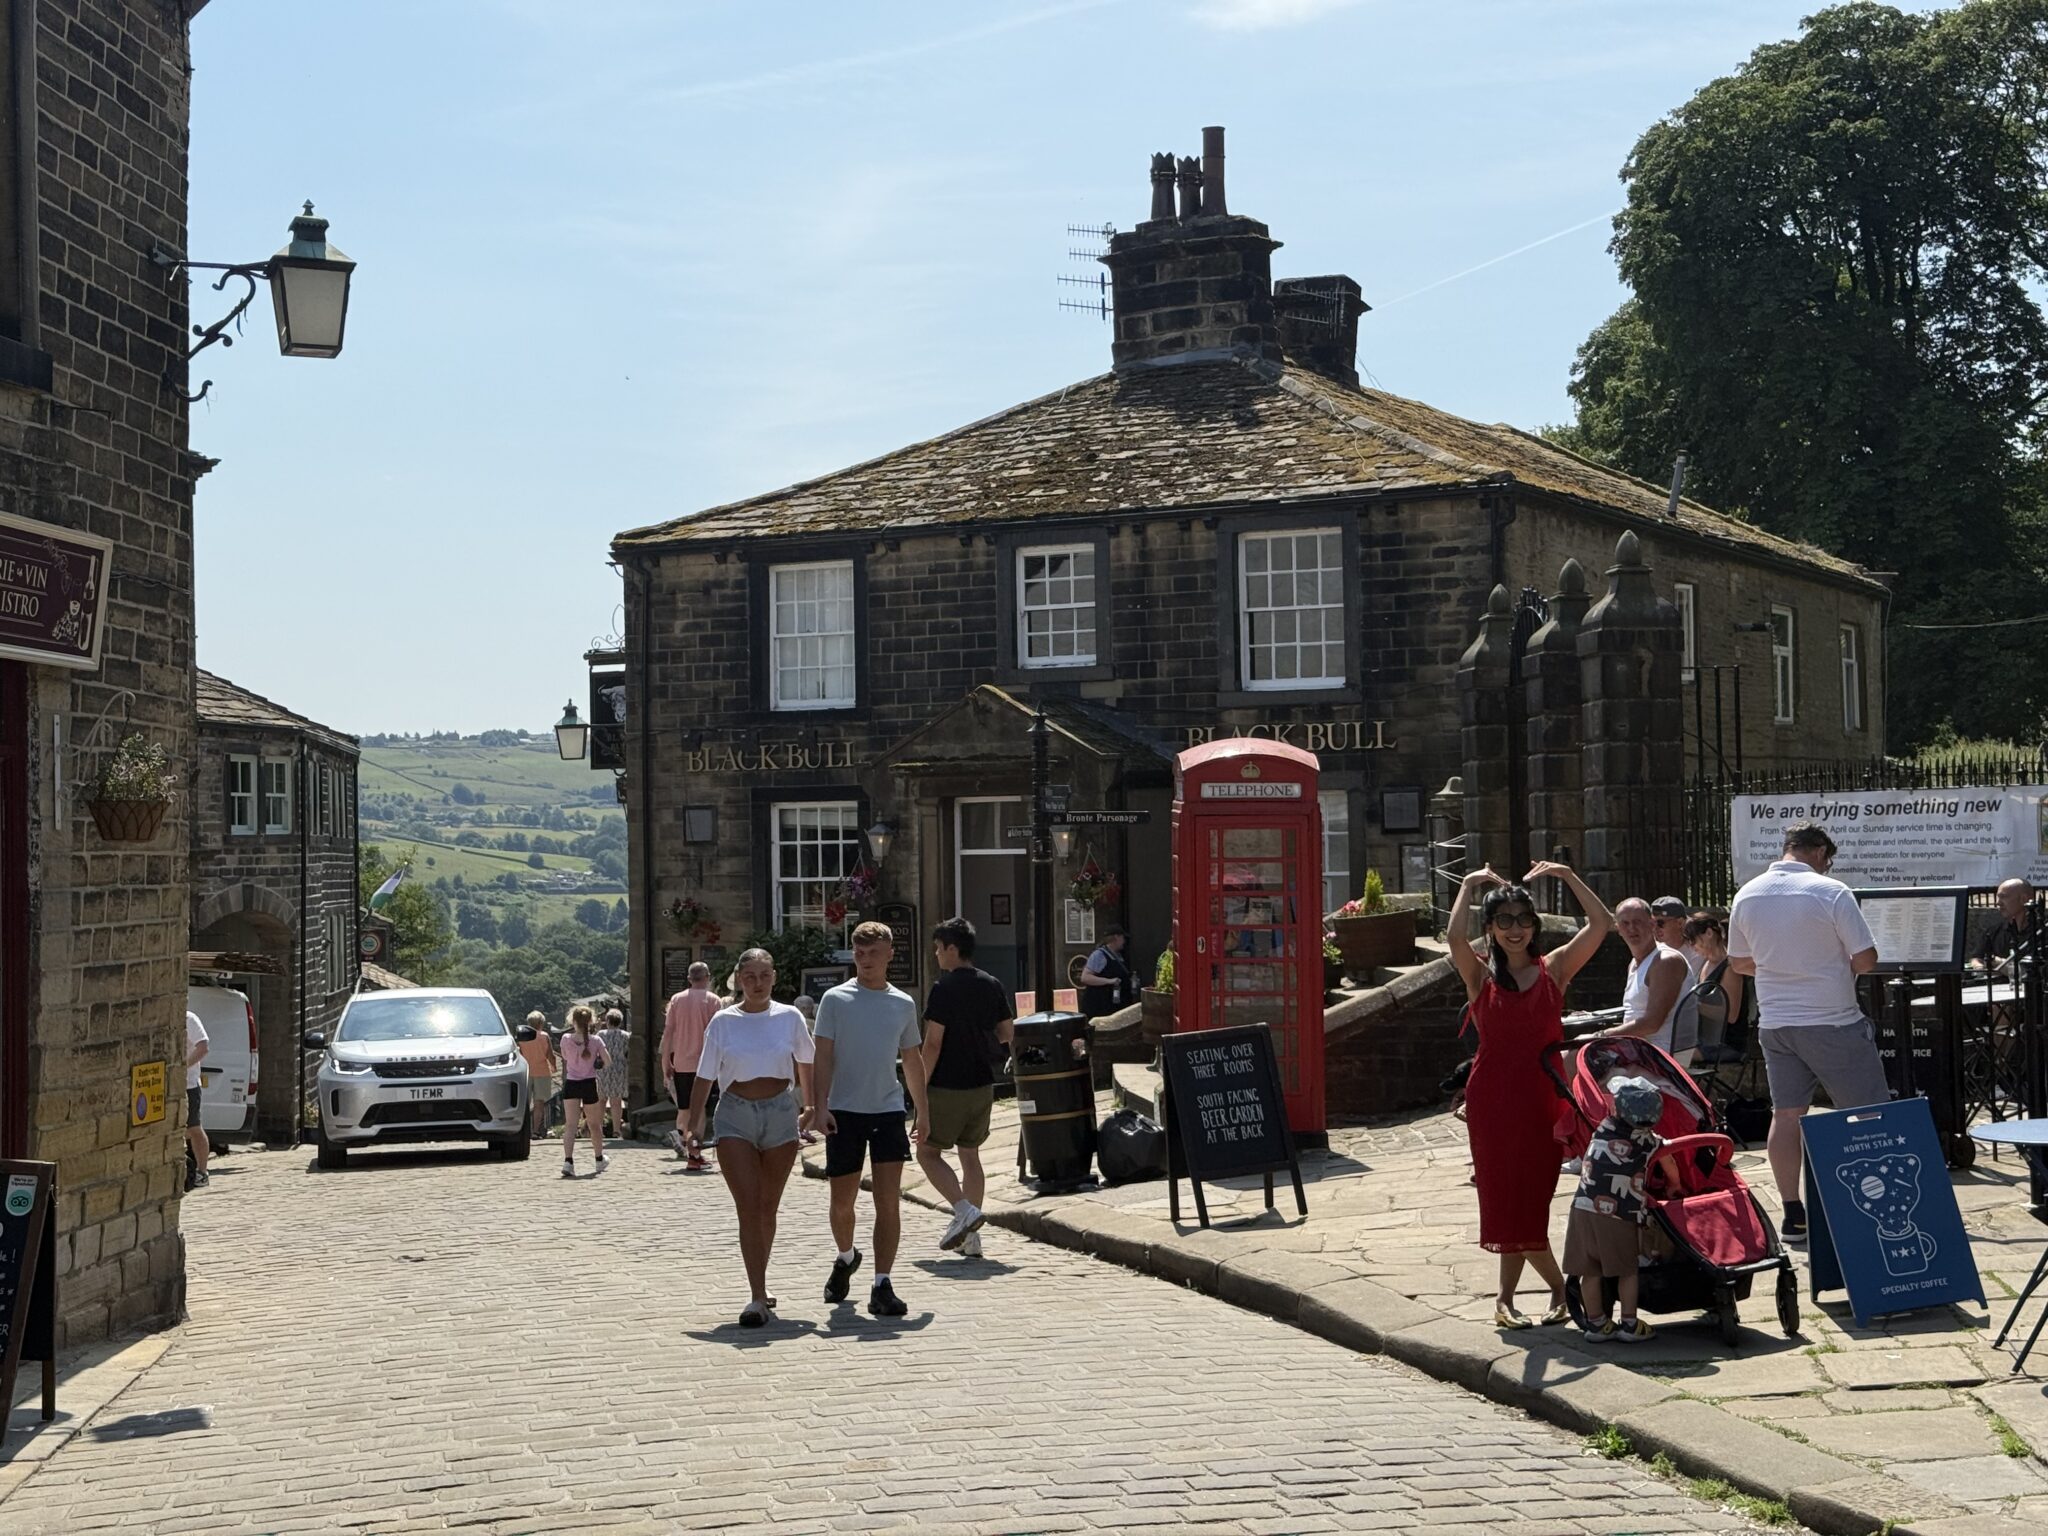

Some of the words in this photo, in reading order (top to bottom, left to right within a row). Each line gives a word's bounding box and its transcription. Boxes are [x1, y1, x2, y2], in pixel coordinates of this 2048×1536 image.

[25, 564, 48, 589] VIN
[1304, 720, 1397, 751] BULL
[687, 744, 781, 773] BLACK
[786, 741, 872, 769] BULL
[1208, 784, 1294, 797] TELEPHONE
[1066, 813, 1093, 823] Bronte
[1096, 813, 1138, 823] Parsonage
[1750, 803, 1775, 819] We
[1780, 806, 1805, 818] are
[1810, 801, 1859, 821] trying
[1864, 798, 1959, 818] something
[1963, 799, 2002, 813] new
[1760, 827, 1780, 835] From
[1830, 825, 1847, 834] April
[1862, 824, 1894, 834] Sunday
[1895, 823, 1924, 832] service
[1926, 823, 1944, 832] time
[1946, 822, 1952, 831] is
[1750, 840, 1778, 849] Bringing
[1882, 838, 1895, 846] and
[1944, 836, 1963, 845] quiet
[1964, 836, 1978, 844] and
[1980, 836, 1992, 844] the
[1859, 851, 1898, 859] celebration
[1911, 851, 1944, 860] everyone
[1831, 866, 1868, 874] something
[1920, 873, 1956, 881] welcome!
[1186, 1046, 1229, 1065] SEATING
[1231, 1043, 1255, 1058] OVER
[1192, 1063, 1217, 1079] THREE
[1223, 1059, 1254, 1075] ROOMS
[422, 1088, 444, 1098] FMR
[1197, 1092, 1225, 1109] SOUTH
[1227, 1087, 1260, 1104] FACING
[1201, 1108, 1229, 1129] BEER
[1229, 1103, 1265, 1124] GARDEN
[1207, 1129, 1217, 1144] AT
[1220, 1126, 1238, 1142] THE
[1240, 1123, 1265, 1140] BACK
[1843, 1142, 1871, 1153] NORTH
[1872, 1138, 1894, 1149] STAR
[1881, 1282, 1919, 1295] SPECIALTY
[1920, 1277, 1948, 1289] COFFEE
